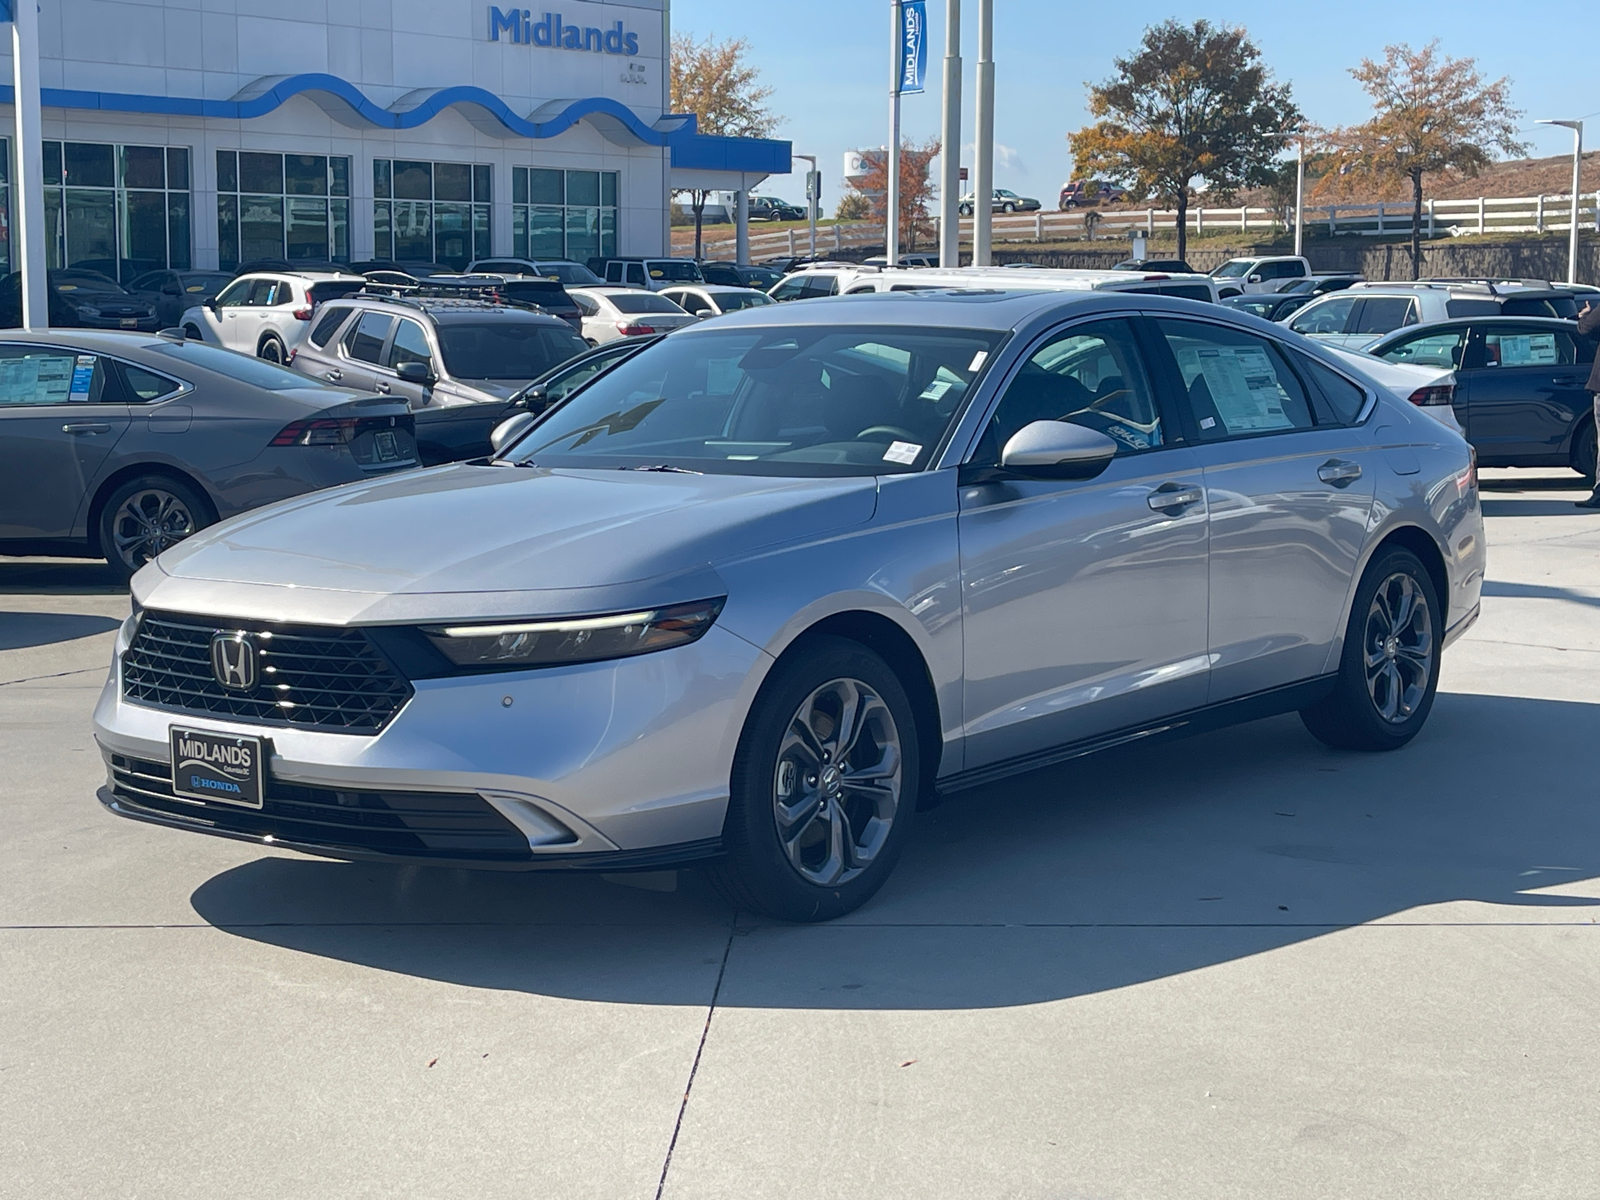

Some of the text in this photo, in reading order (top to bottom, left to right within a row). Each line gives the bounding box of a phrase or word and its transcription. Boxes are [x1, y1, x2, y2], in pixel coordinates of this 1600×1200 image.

[488, 6, 639, 56] Midlands
[905, 7, 916, 85] MIDLANDS
[178, 738, 251, 767] MIDLANDS
[201, 778, 242, 793] HONDA
